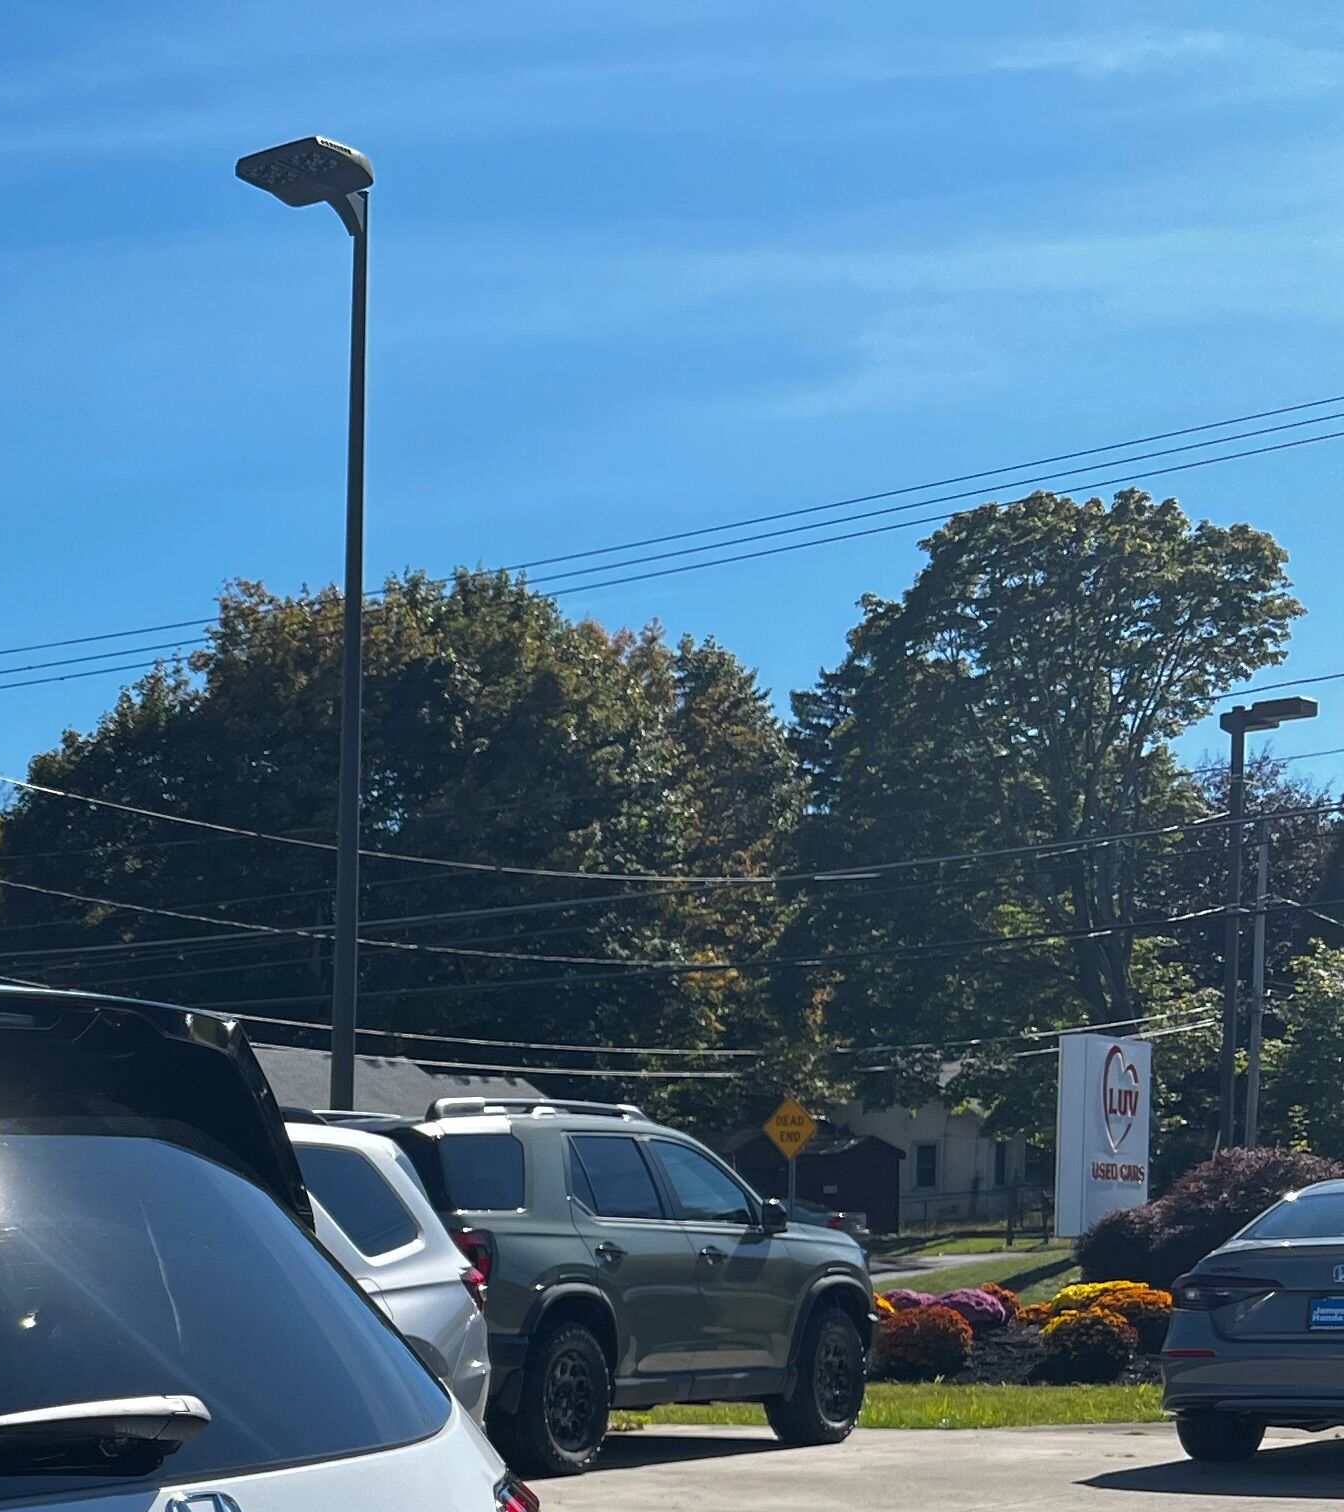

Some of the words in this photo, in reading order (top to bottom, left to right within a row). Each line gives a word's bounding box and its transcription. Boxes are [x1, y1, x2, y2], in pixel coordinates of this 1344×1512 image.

[1108, 1087, 1139, 1117] LUV
[775, 1115, 805, 1128] DEAD
[779, 1130, 801, 1143] END
[1091, 1161, 1118, 1180] USED
[1120, 1164, 1145, 1183] CARS
